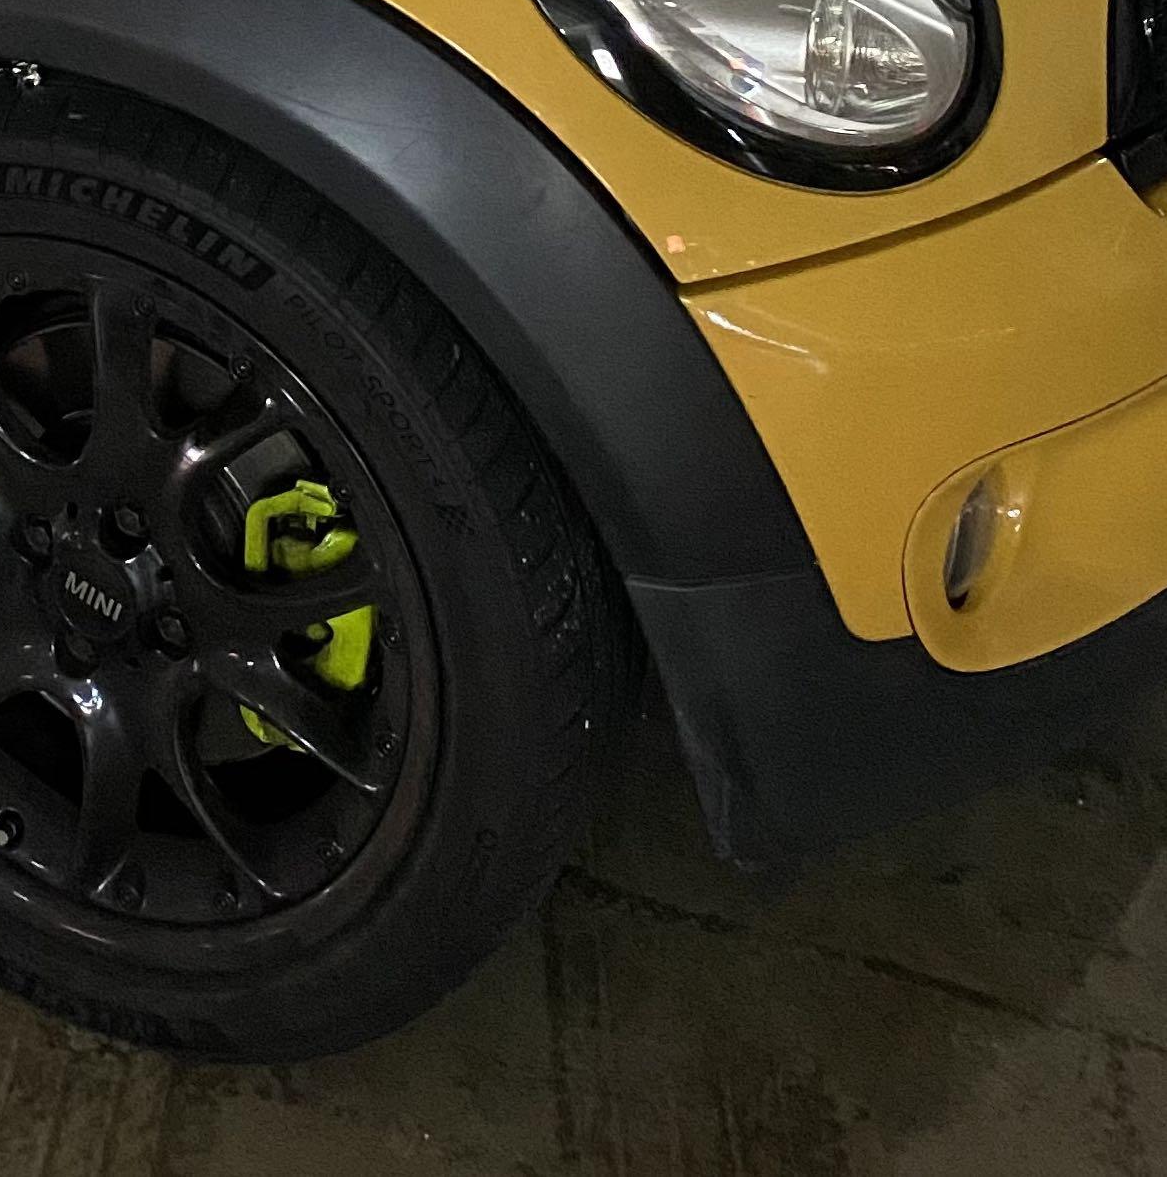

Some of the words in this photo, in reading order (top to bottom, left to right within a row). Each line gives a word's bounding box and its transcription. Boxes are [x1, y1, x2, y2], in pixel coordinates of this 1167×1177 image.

[3, 164, 258, 280] MICHELIN
[282, 292, 362, 361] PILOT
[364, 374, 437, 468] SPORT
[64, 571, 122, 623] MINI
